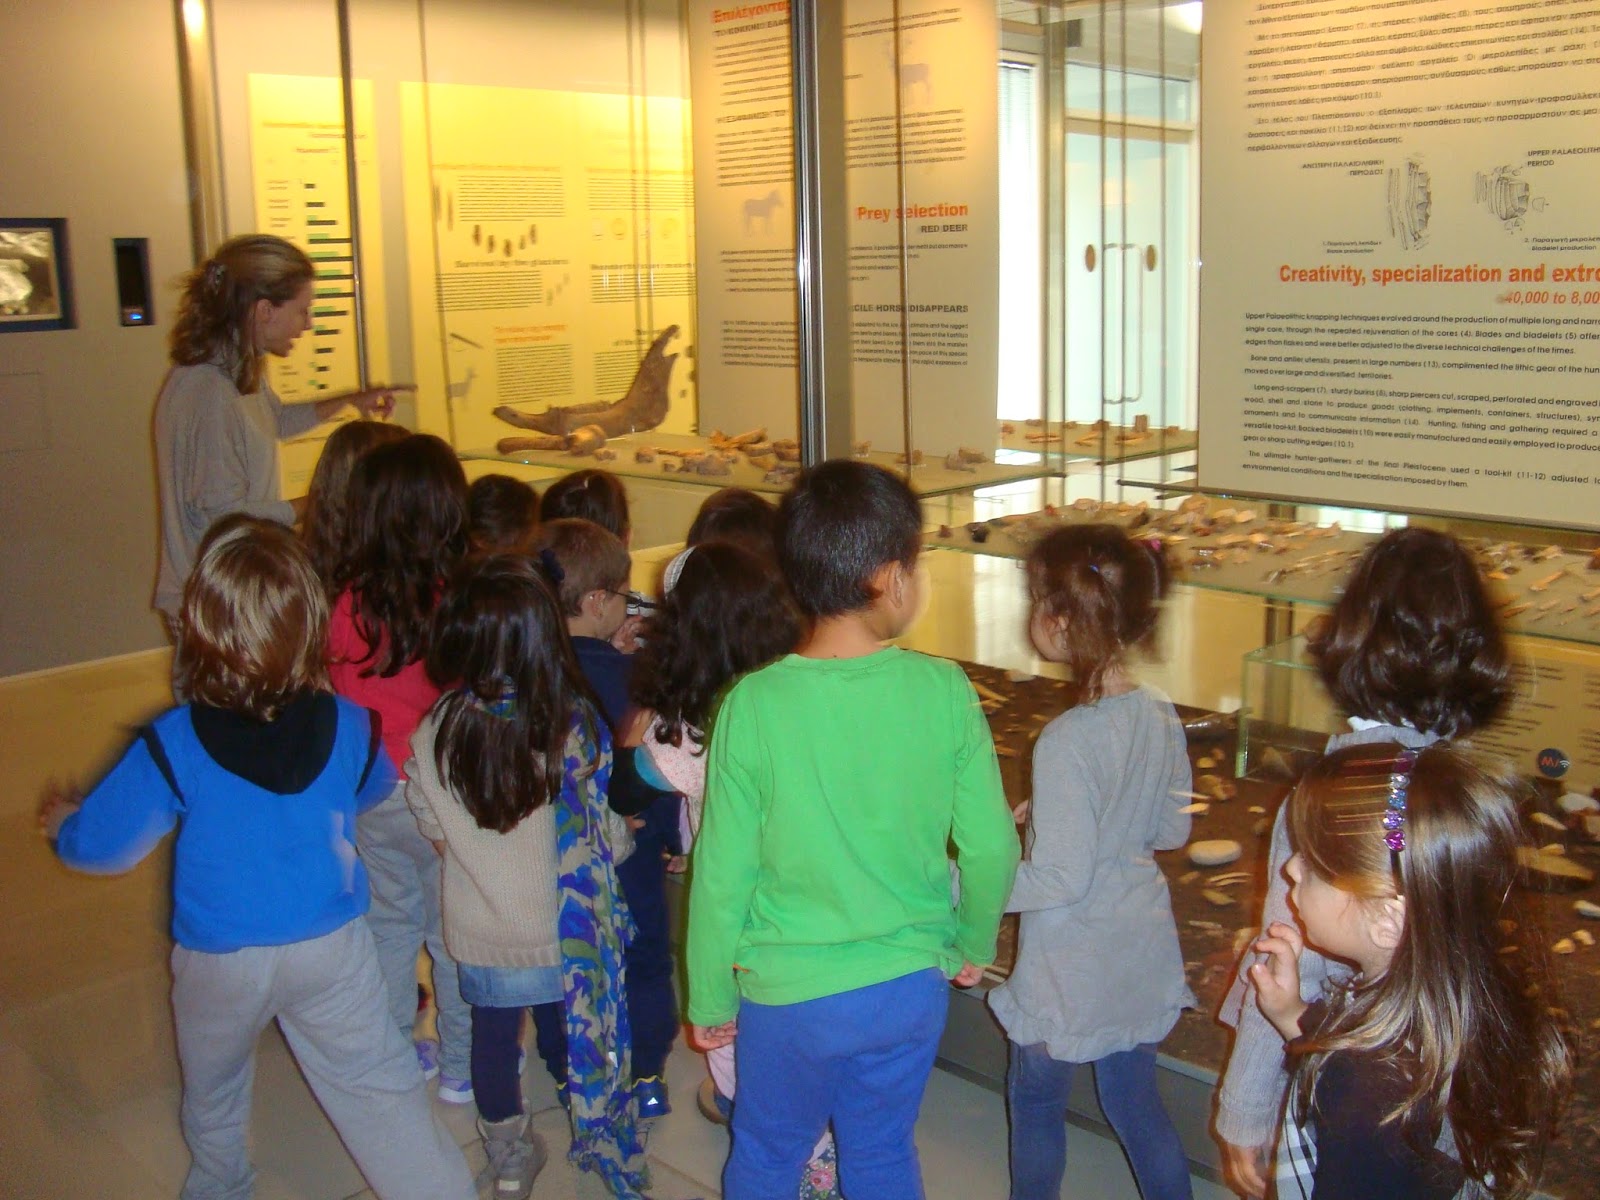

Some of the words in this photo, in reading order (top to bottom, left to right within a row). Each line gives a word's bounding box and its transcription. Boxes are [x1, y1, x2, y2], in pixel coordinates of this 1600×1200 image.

[857, 206, 891, 222] Prey
[896, 203, 969, 218] selection
[942, 224, 969, 232] DEER
[1279, 265, 1366, 287] Creativity,
[1372, 265, 1501, 287] specialization
[1509, 263, 1545, 283] and
[1553, 291, 1567, 305] to
[909, 305, 969, 313] DISAPPEARS
[1454, 316, 1498, 324] production
[1508, 317, 1541, 325] multiple
[1565, 332, 1577, 341] (5)
[1481, 345, 1526, 353] challenges
[1442, 361, 1498, 370] complimented
[1410, 391, 1440, 400] piercers
[1457, 393, 1492, 402] scraped,
[1492, 395, 1537, 404] perforated
[1555, 398, 1598, 407] engraved
[1461, 421, 1486, 430] fishing
[1490, 422, 1506, 430] and
[1509, 424, 1549, 434] gathering
[1552, 426, 1588, 436] required
[1416, 432, 1471, 442] manufactured
[1471, 436, 1488, 444] and
[1488, 437, 1512, 446] easily
[1512, 439, 1556, 449] employed
[1404, 475, 1436, 485] imposed
[1450, 465, 1470, 473] used
[1484, 468, 1512, 476] tool-kit
[1516, 471, 1546, 480] (11-12)
[1551, 473, 1589, 484] adjusted
